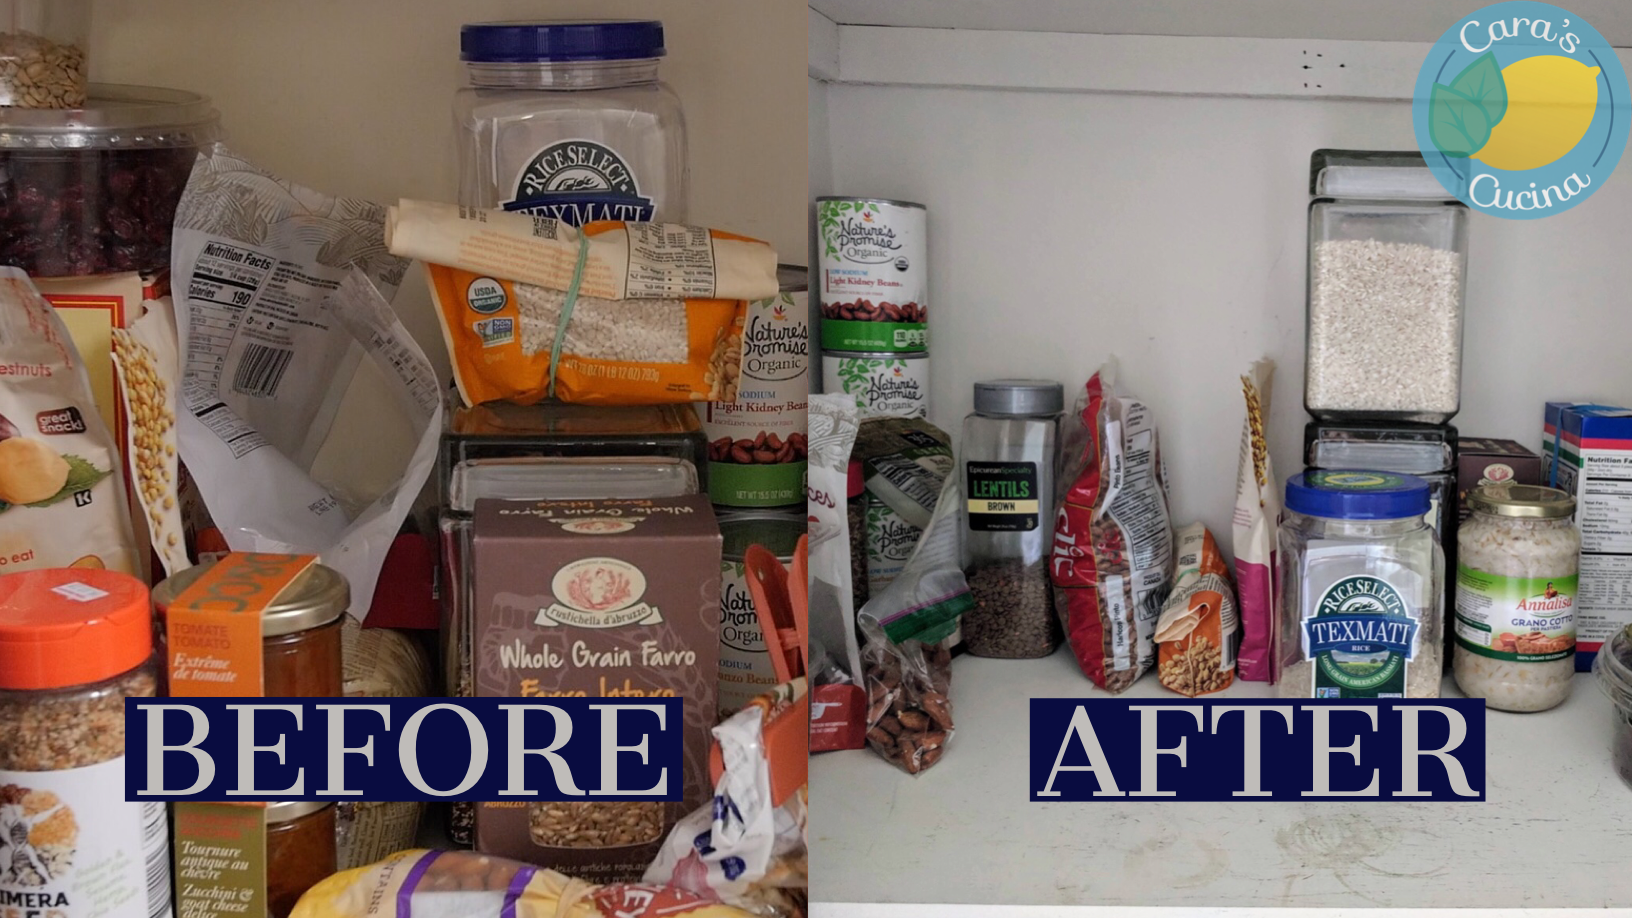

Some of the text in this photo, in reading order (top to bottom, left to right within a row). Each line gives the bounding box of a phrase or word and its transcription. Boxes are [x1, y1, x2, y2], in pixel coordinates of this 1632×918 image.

[511, 203, 645, 227] EXMATI
[840, 217, 896, 239] Nature's
[837, 234, 902, 252] Promise
[204, 243, 272, 271] Nutrition Facts
[846, 247, 888, 259] Organic
[847, 277, 875, 287] Kidney
[189, 284, 251, 306] Calories 190
[474, 286, 497, 297] USDA
[0, 362, 52, 377] estnuts
[748, 356, 801, 375] Organic
[870, 373, 919, 391] Nature's
[866, 389, 923, 407] Promise
[877, 400, 914, 412] Organic
[715, 401, 743, 413] Light
[746, 402, 784, 415] Kidney
[39, 410, 73, 427] great
[40, 419, 83, 433] snack!
[973, 480, 1030, 498] LENTILS
[987, 502, 1015, 511] BROWN
[11, 550, 34, 564] eat
[1323, 579, 1401, 611] RICESELECT
[1516, 597, 1573, 611] Annalisa
[551, 606, 647, 626] rustichella d'abruzzo
[1511, 618, 1547, 627] GRANO
[1549, 614, 1573, 626] COTTO
[173, 623, 228, 636] TOMATE
[1312, 620, 1410, 645] TEXMATI
[174, 636, 231, 649] TOMATO
[500, 638, 696, 670] Whole Grain Farro
[173, 666, 237, 683] de tomate
[1321, 654, 1399, 686] LONG GRAIN AMERICAN BASMATI
[181, 840, 242, 857] Tournure
[231, 861, 249, 871] au
[0, 889, 70, 907] IMERA
[182, 883, 254, 901] Zucchini &
[181, 898, 249, 912] goat cheese
